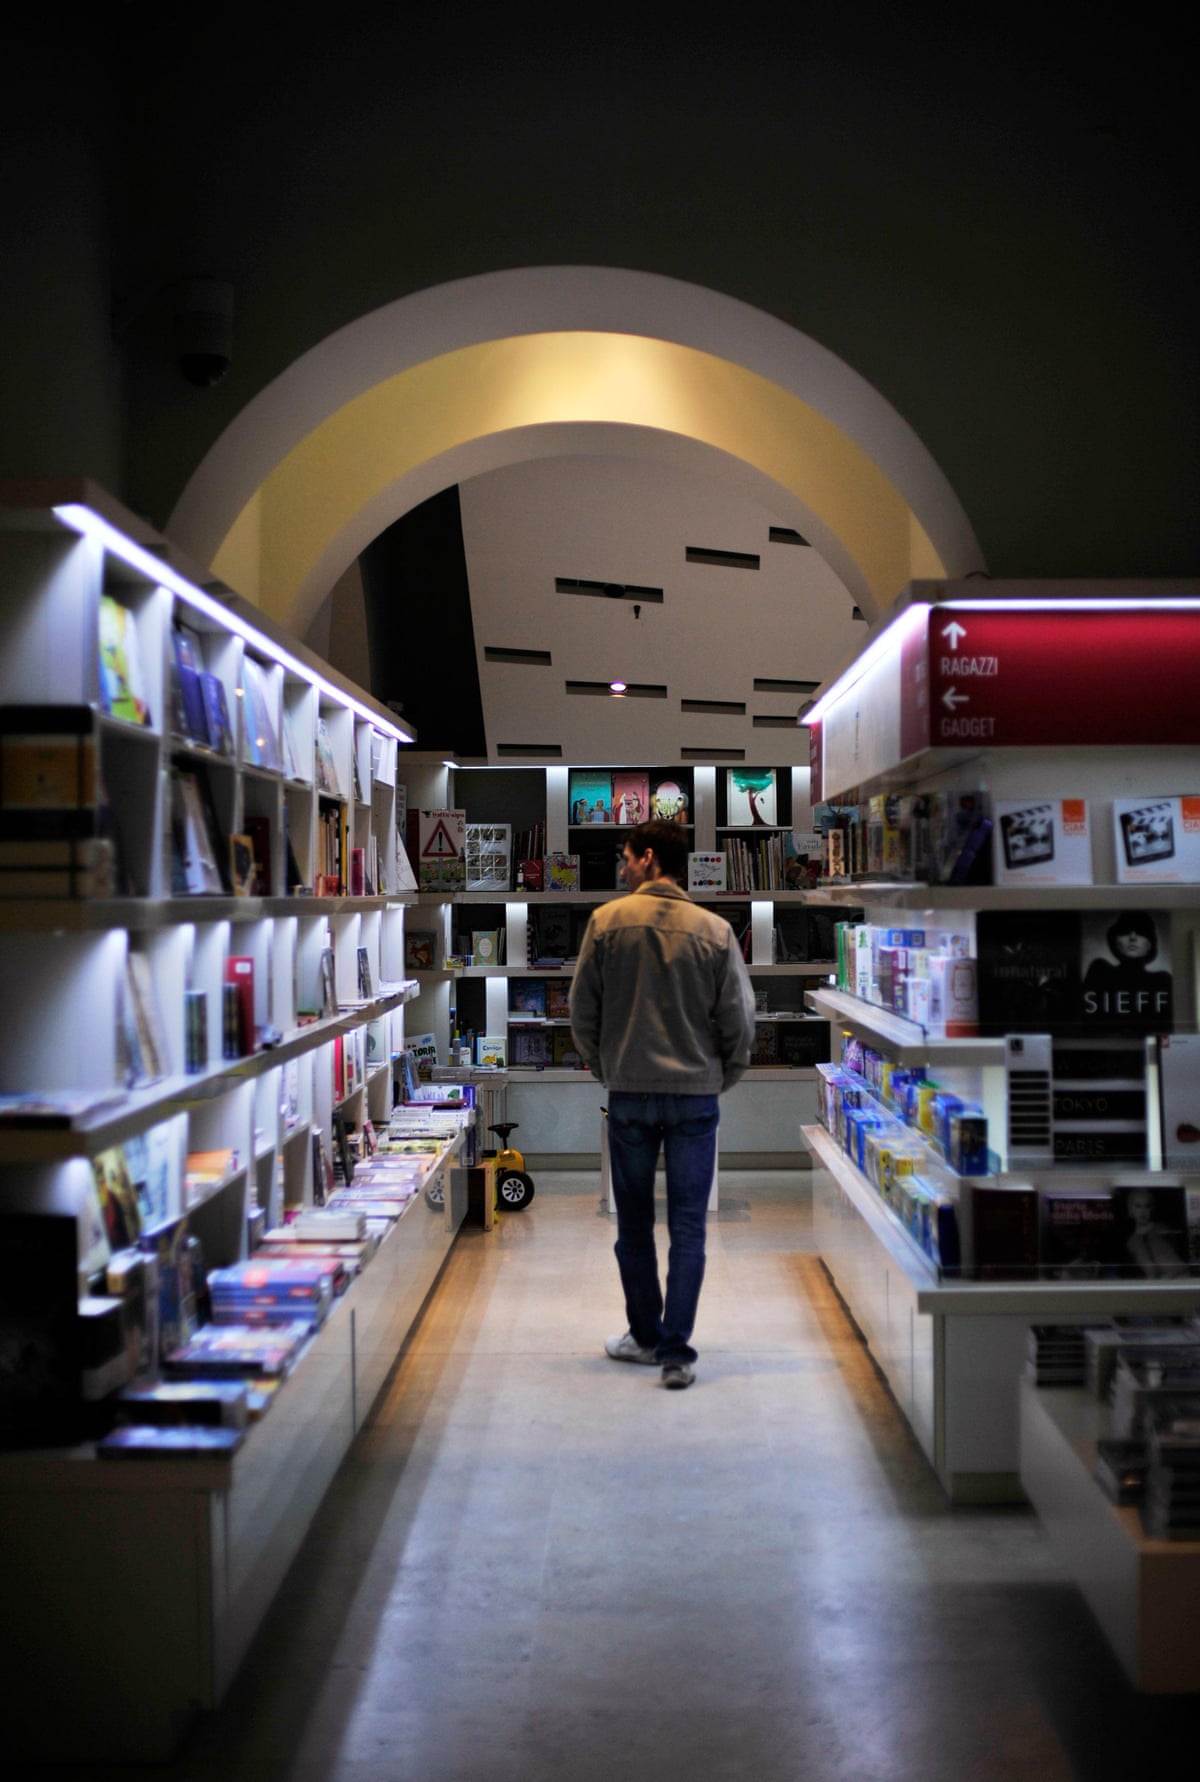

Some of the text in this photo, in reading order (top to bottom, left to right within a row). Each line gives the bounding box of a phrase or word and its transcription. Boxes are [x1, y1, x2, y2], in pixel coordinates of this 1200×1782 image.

[941, 657, 998, 675] RAGAZZI
[941, 718, 996, 736] GADGET
[1184, 821, 1200, 830] CIA
[1083, 991, 1169, 1014] SIEFF
[413, 1046, 436, 1057] TORIA
[1054, 1097, 1109, 1113] TOKYO
[1055, 1139, 1105, 1154] PARIS
